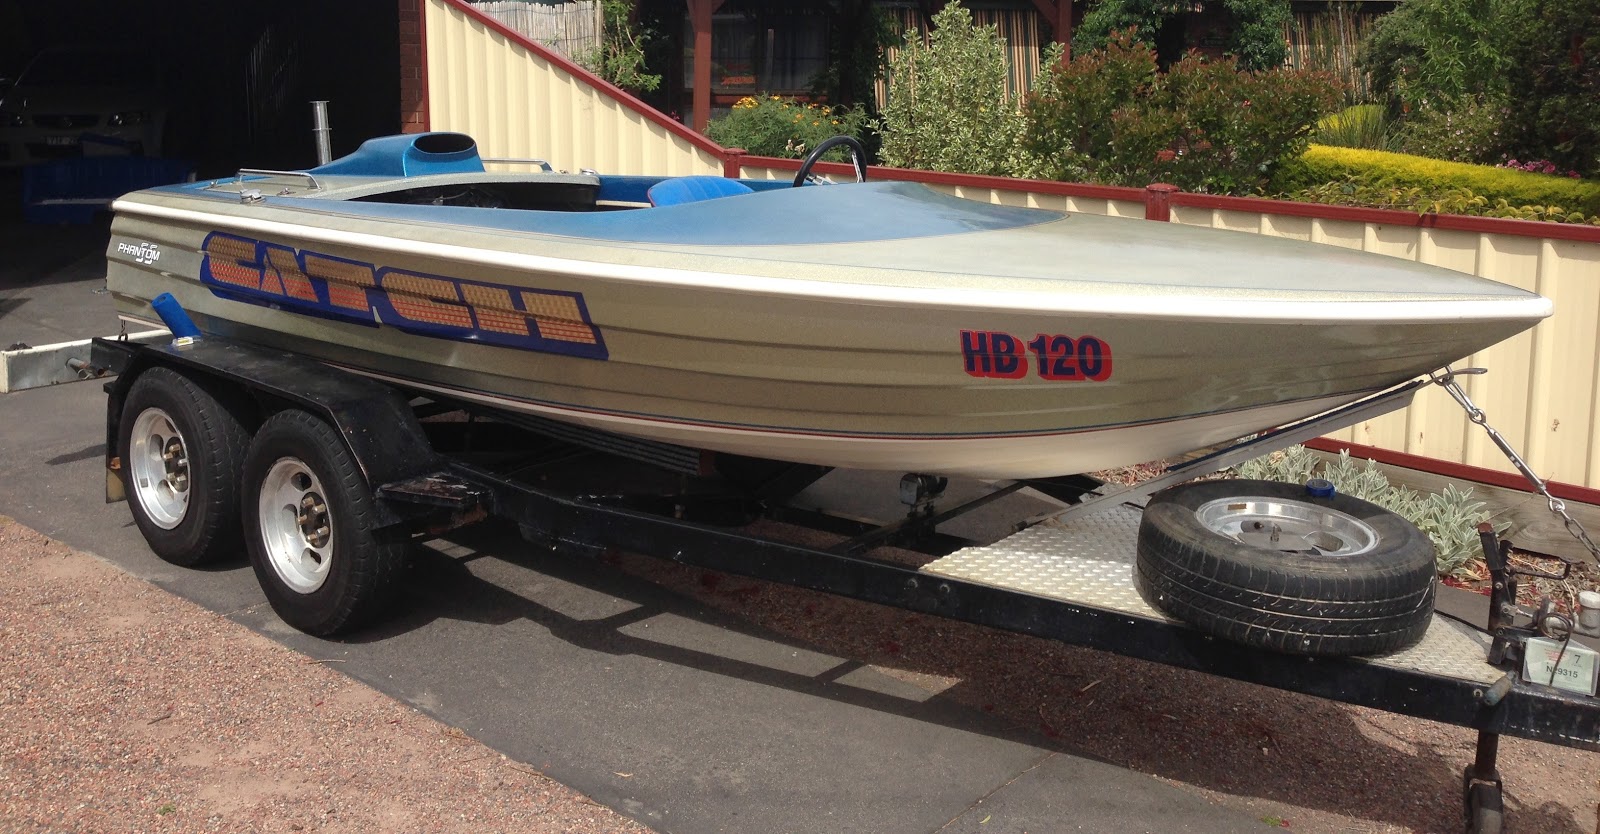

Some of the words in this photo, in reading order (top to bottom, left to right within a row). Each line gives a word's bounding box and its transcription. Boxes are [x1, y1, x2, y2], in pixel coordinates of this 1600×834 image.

[118, 243, 160, 261] PHANTOM
[201, 232, 605, 357] CATCH
[960, 330, 1025, 378] HB
[1028, 334, 1109, 380] 120
[1546, 665, 1579, 679] N9315
